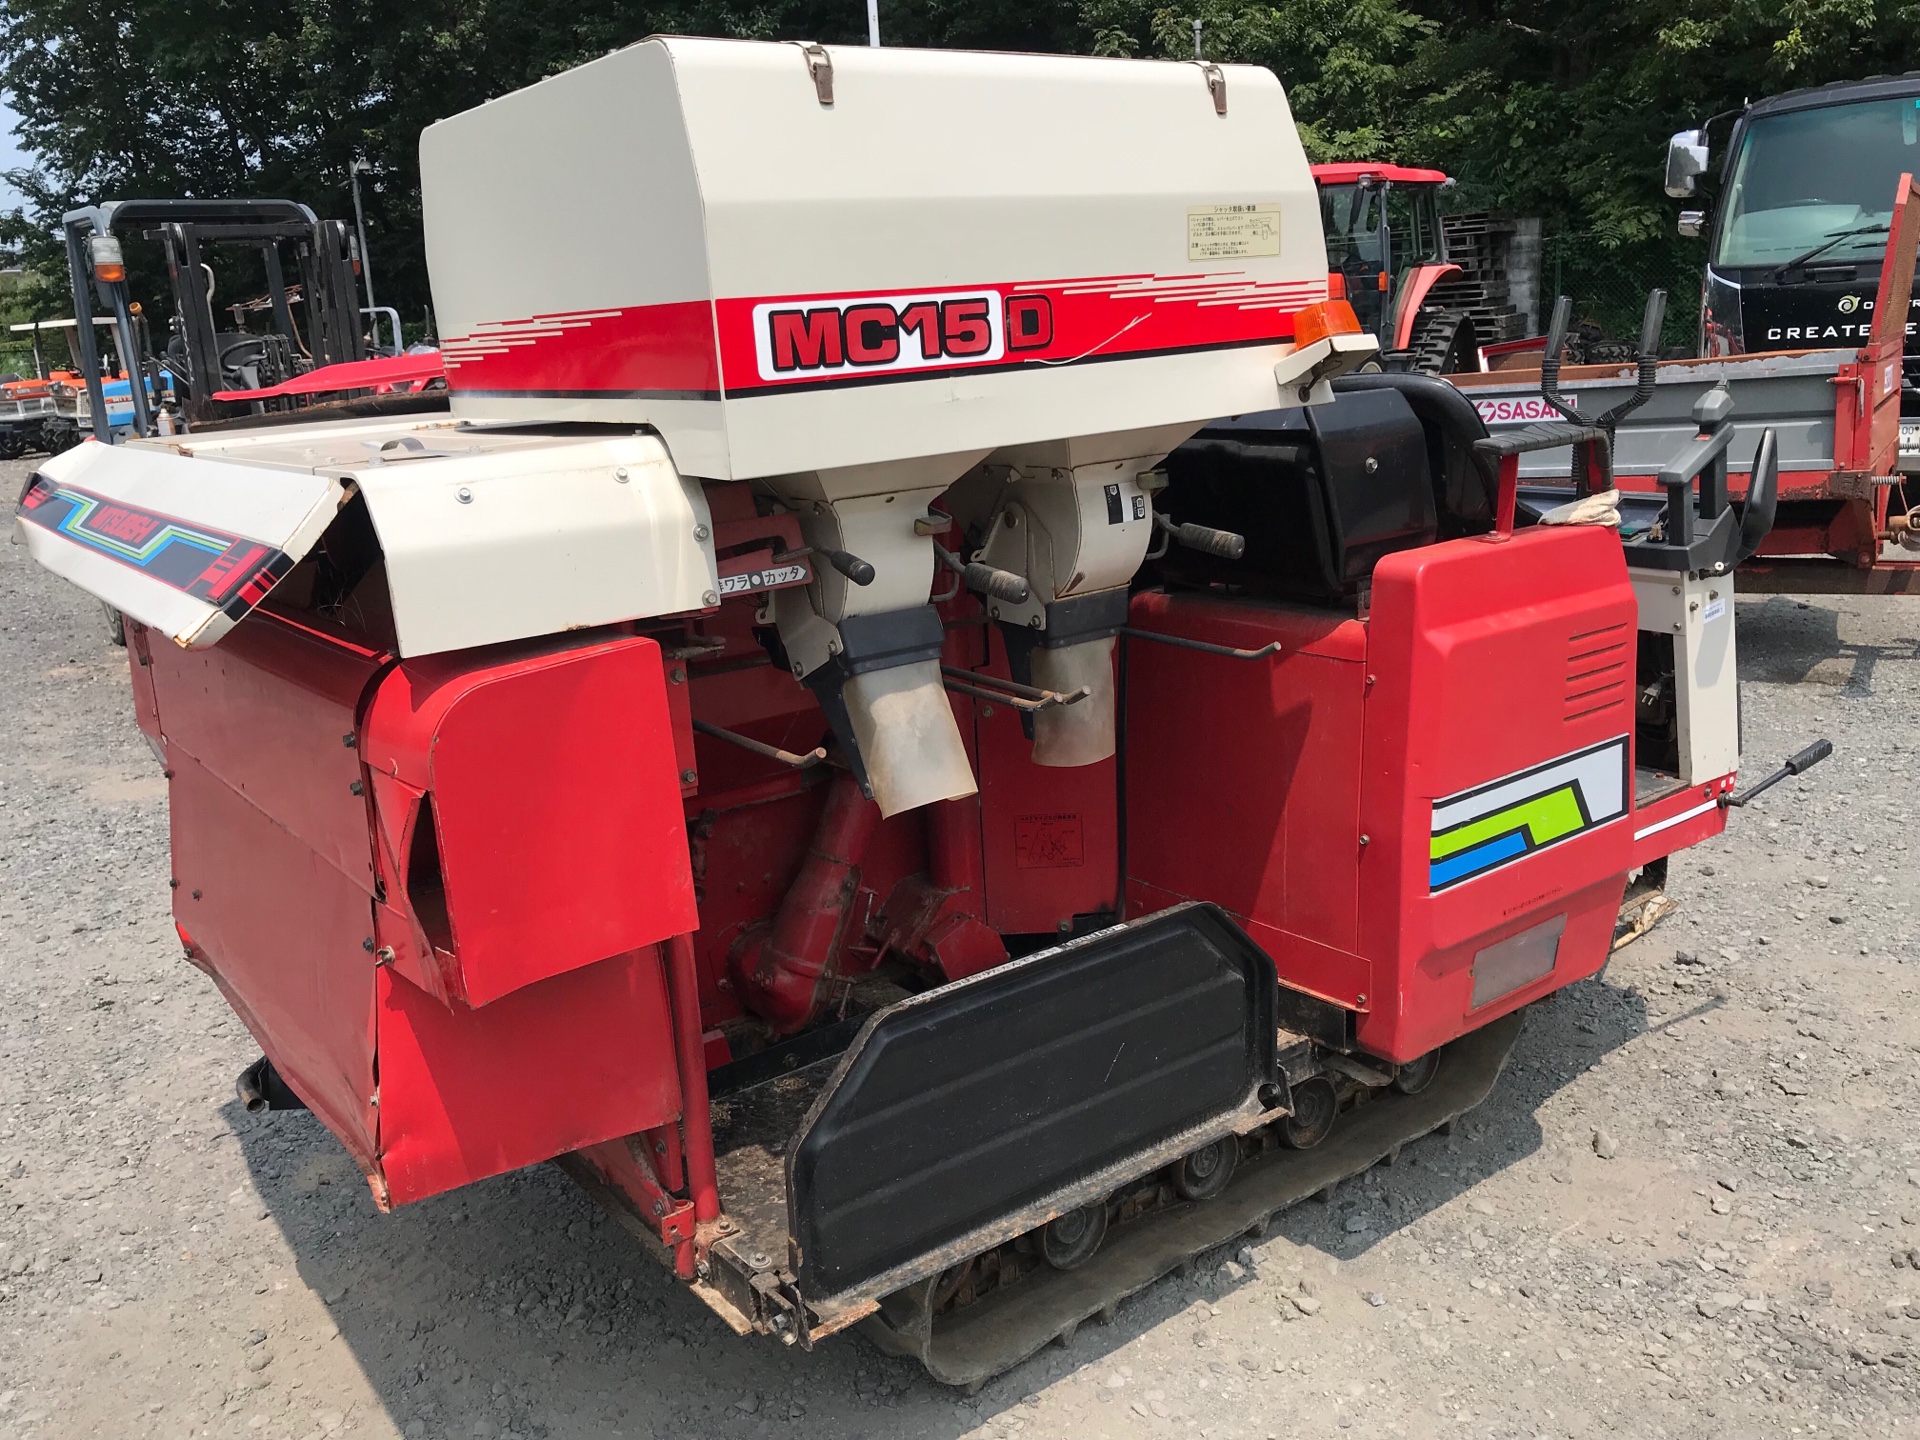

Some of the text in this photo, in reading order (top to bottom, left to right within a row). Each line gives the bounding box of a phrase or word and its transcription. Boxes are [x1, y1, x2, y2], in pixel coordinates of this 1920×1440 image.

[177, 298, 196, 386] TOYOTA
[764, 566, 799, 585] カッタ
